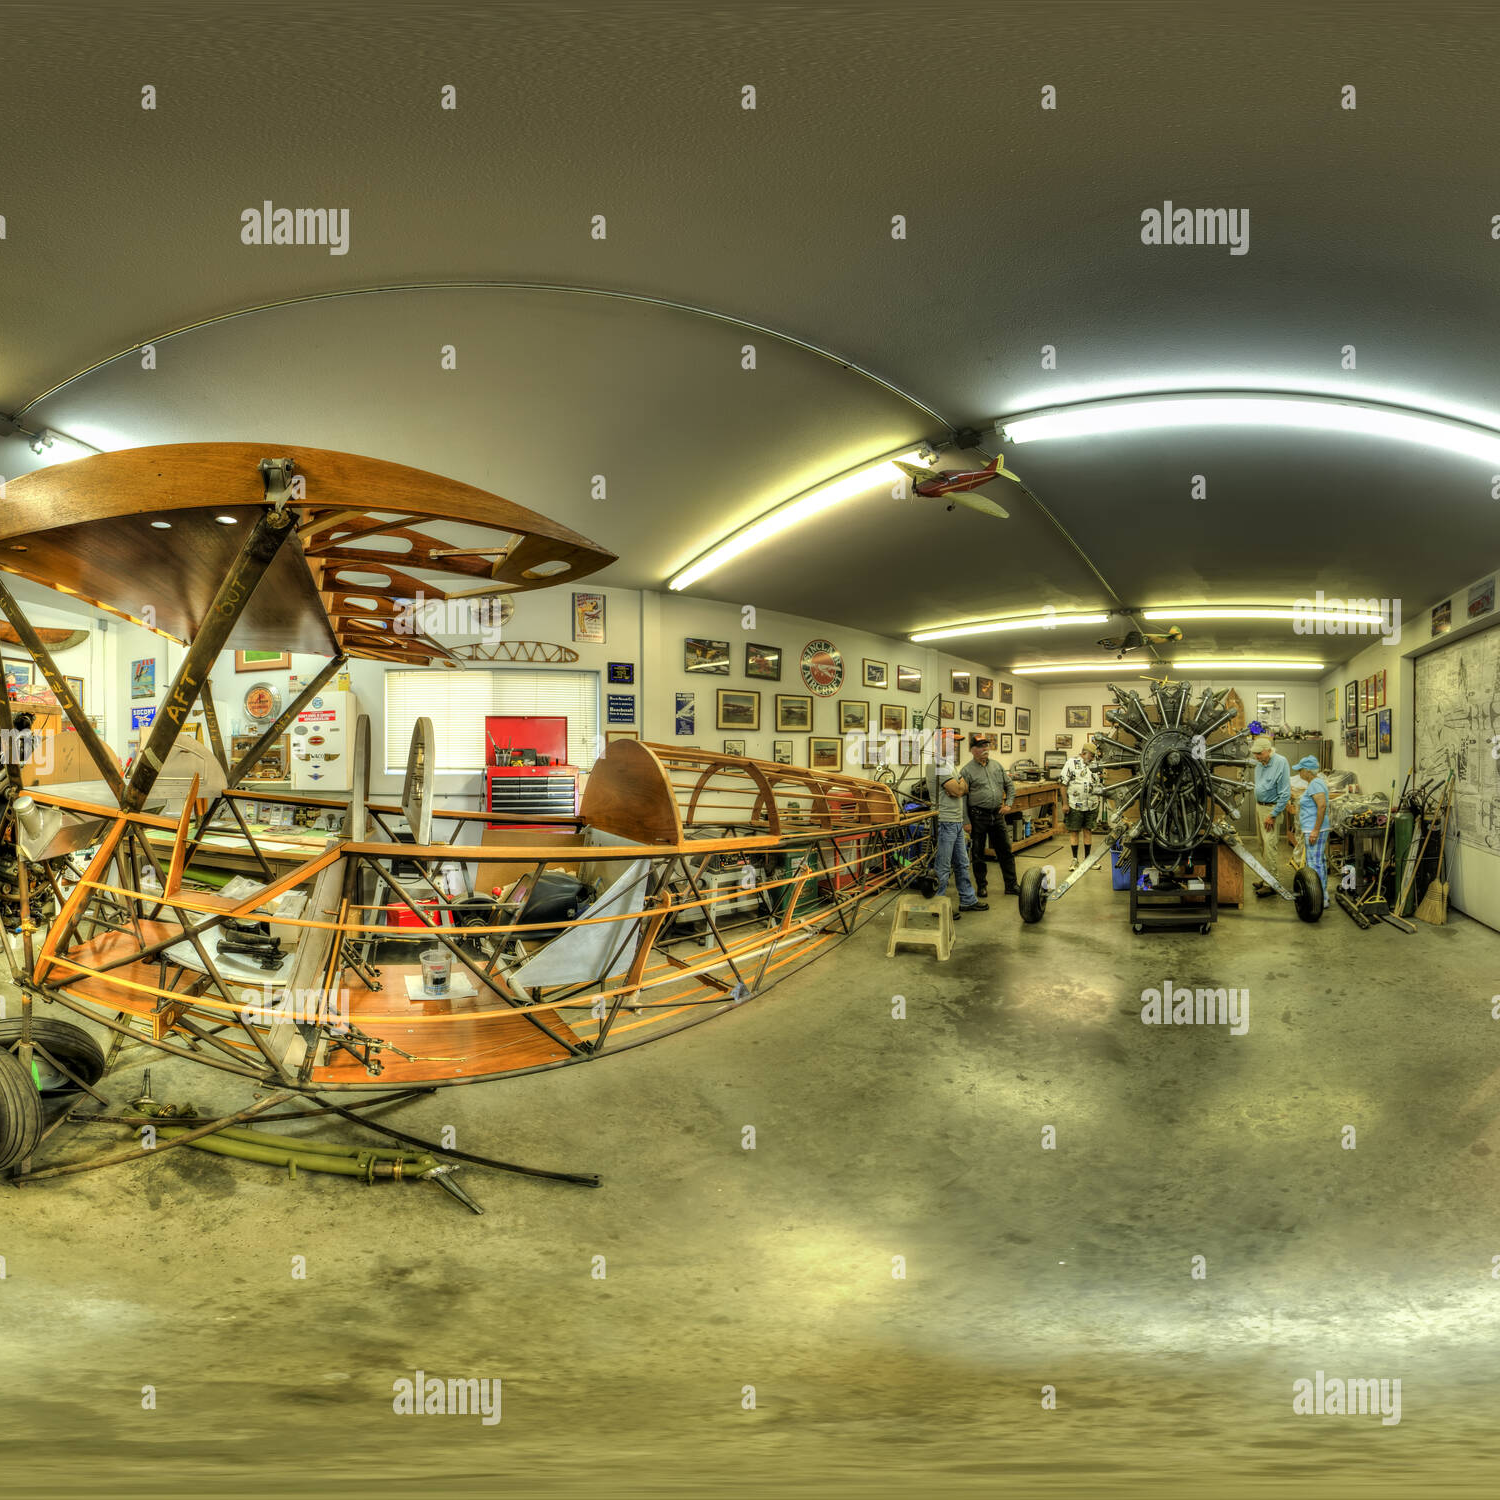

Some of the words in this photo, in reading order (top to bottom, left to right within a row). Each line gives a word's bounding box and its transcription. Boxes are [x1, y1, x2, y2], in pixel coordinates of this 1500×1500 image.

[220, 575, 246, 616] OUT
[133, 708, 155, 716] SOCONY
[166, 663, 197, 725] AFT
